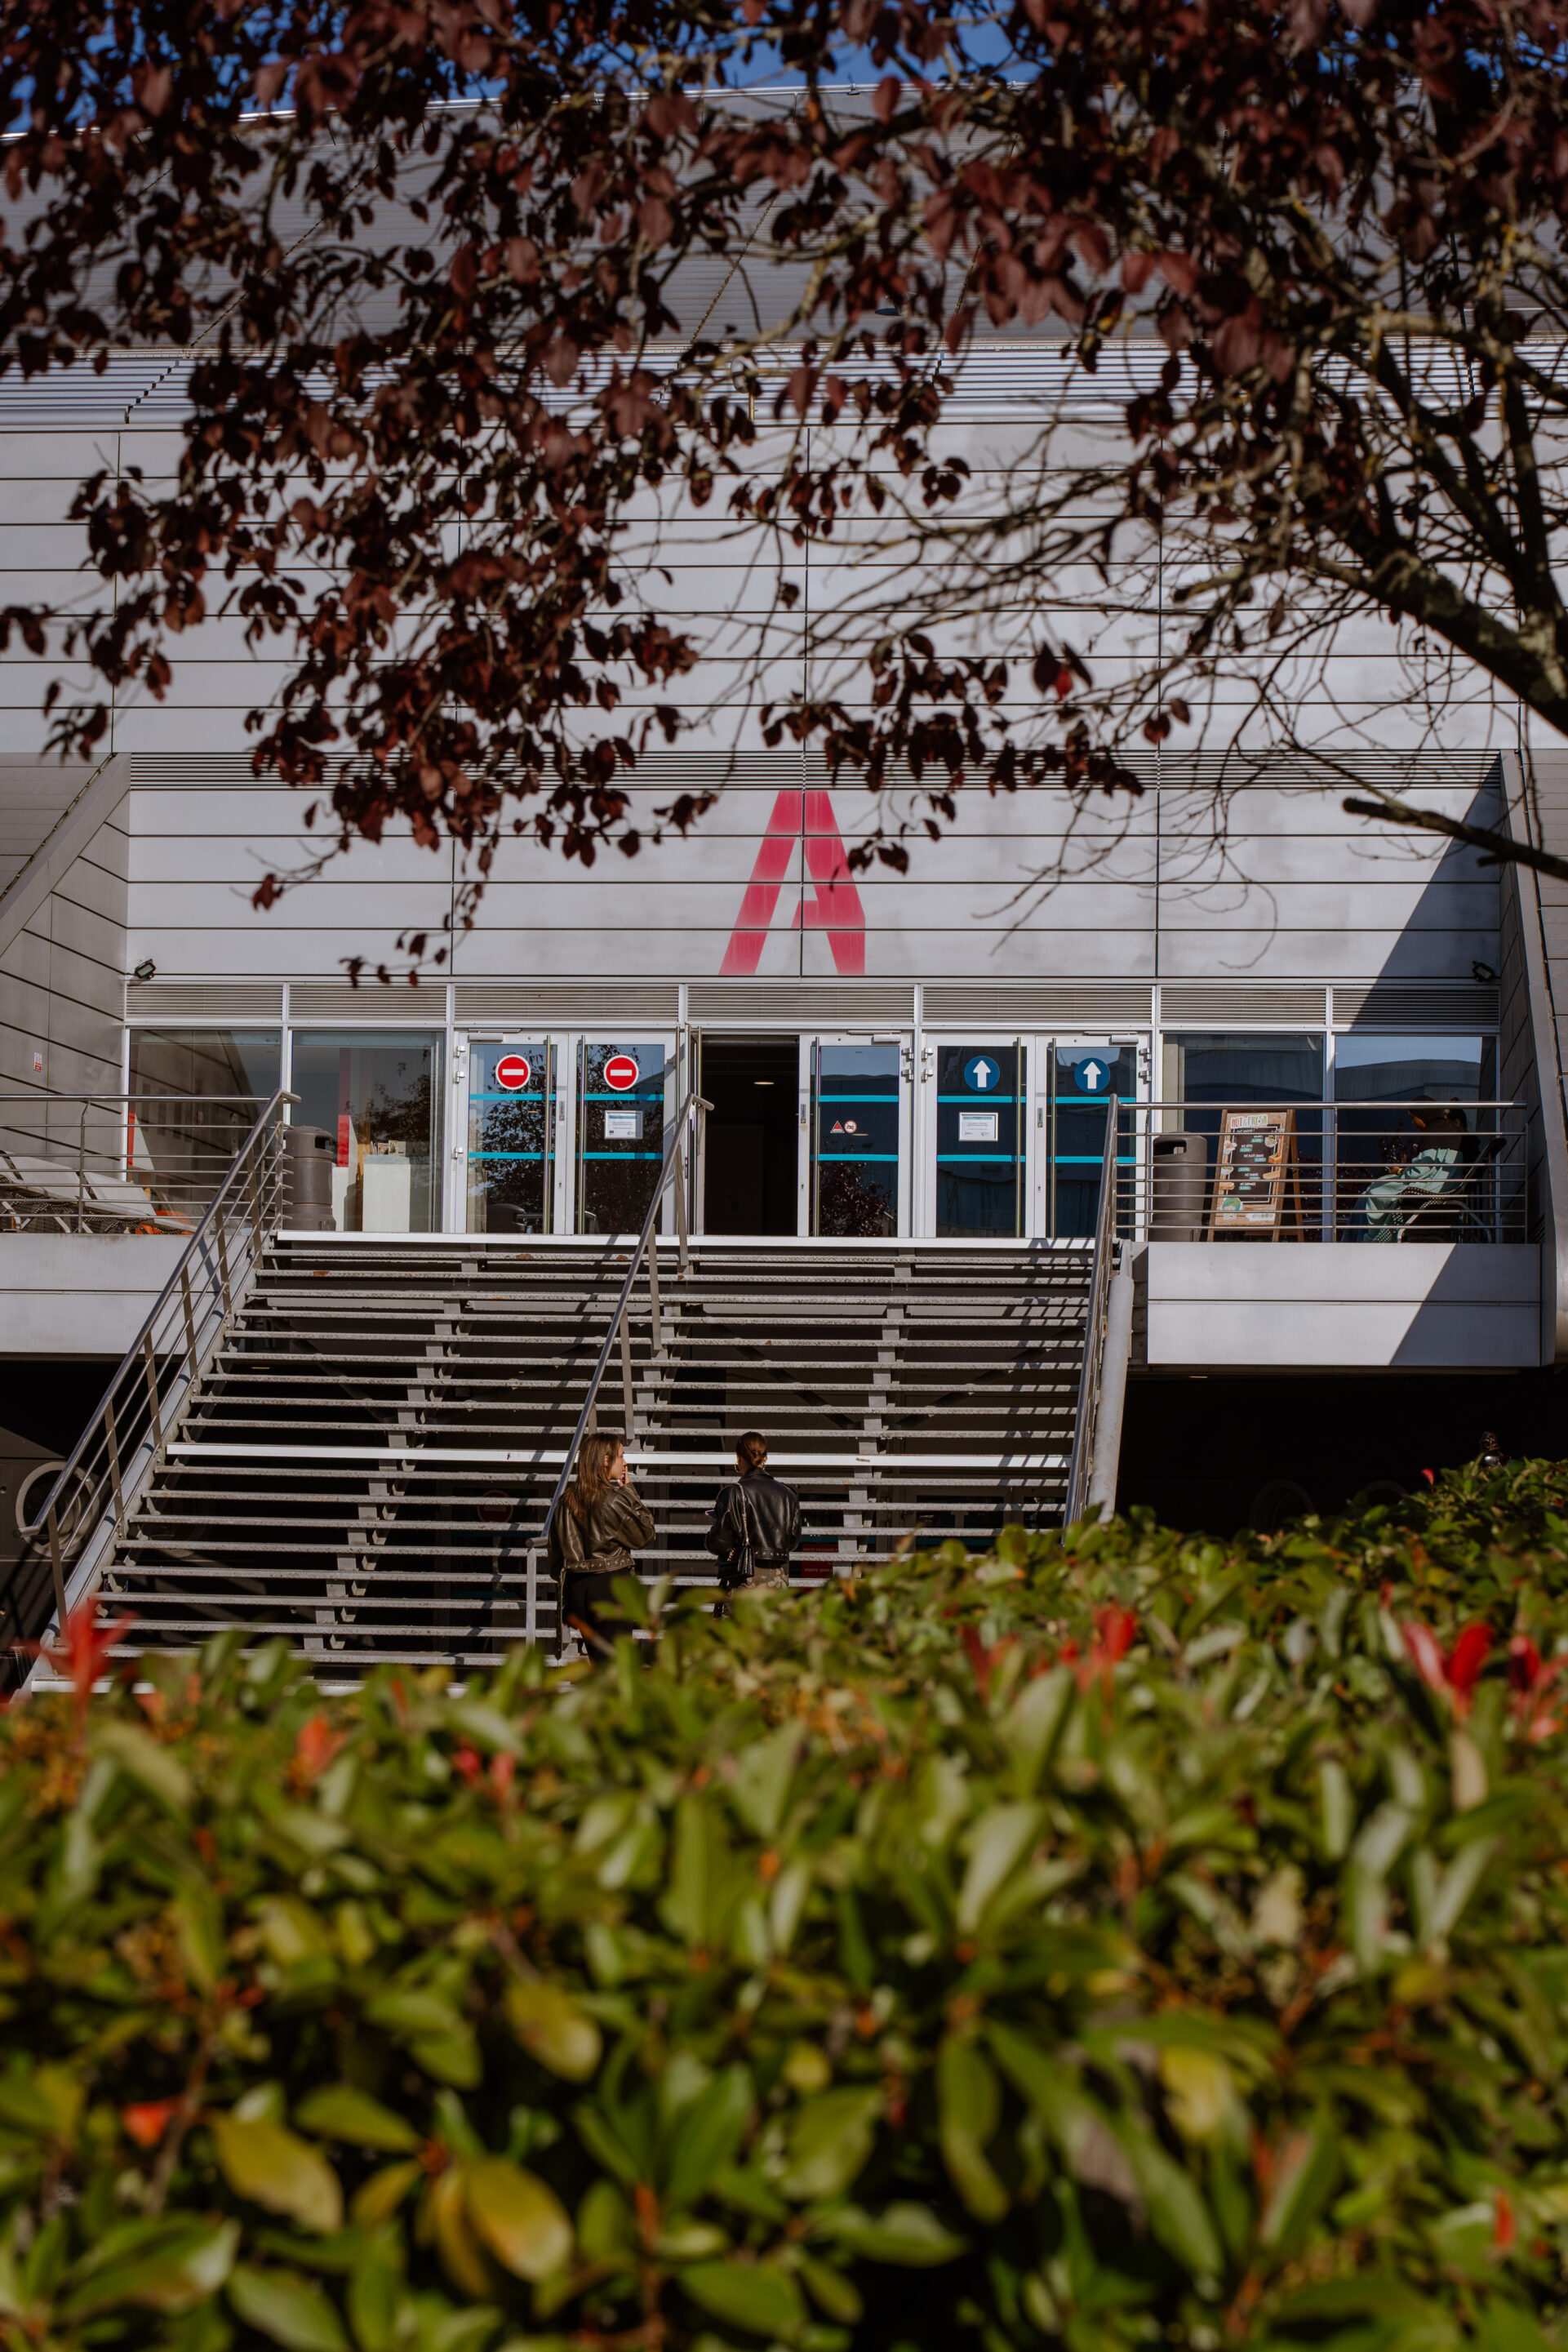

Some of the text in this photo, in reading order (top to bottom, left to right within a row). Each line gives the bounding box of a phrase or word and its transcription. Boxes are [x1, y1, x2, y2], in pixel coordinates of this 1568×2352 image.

[717, 790, 866, 976] A
[1232, 1117, 1242, 1127] HOT
[1247, 1115, 1267, 1126] FRESH
